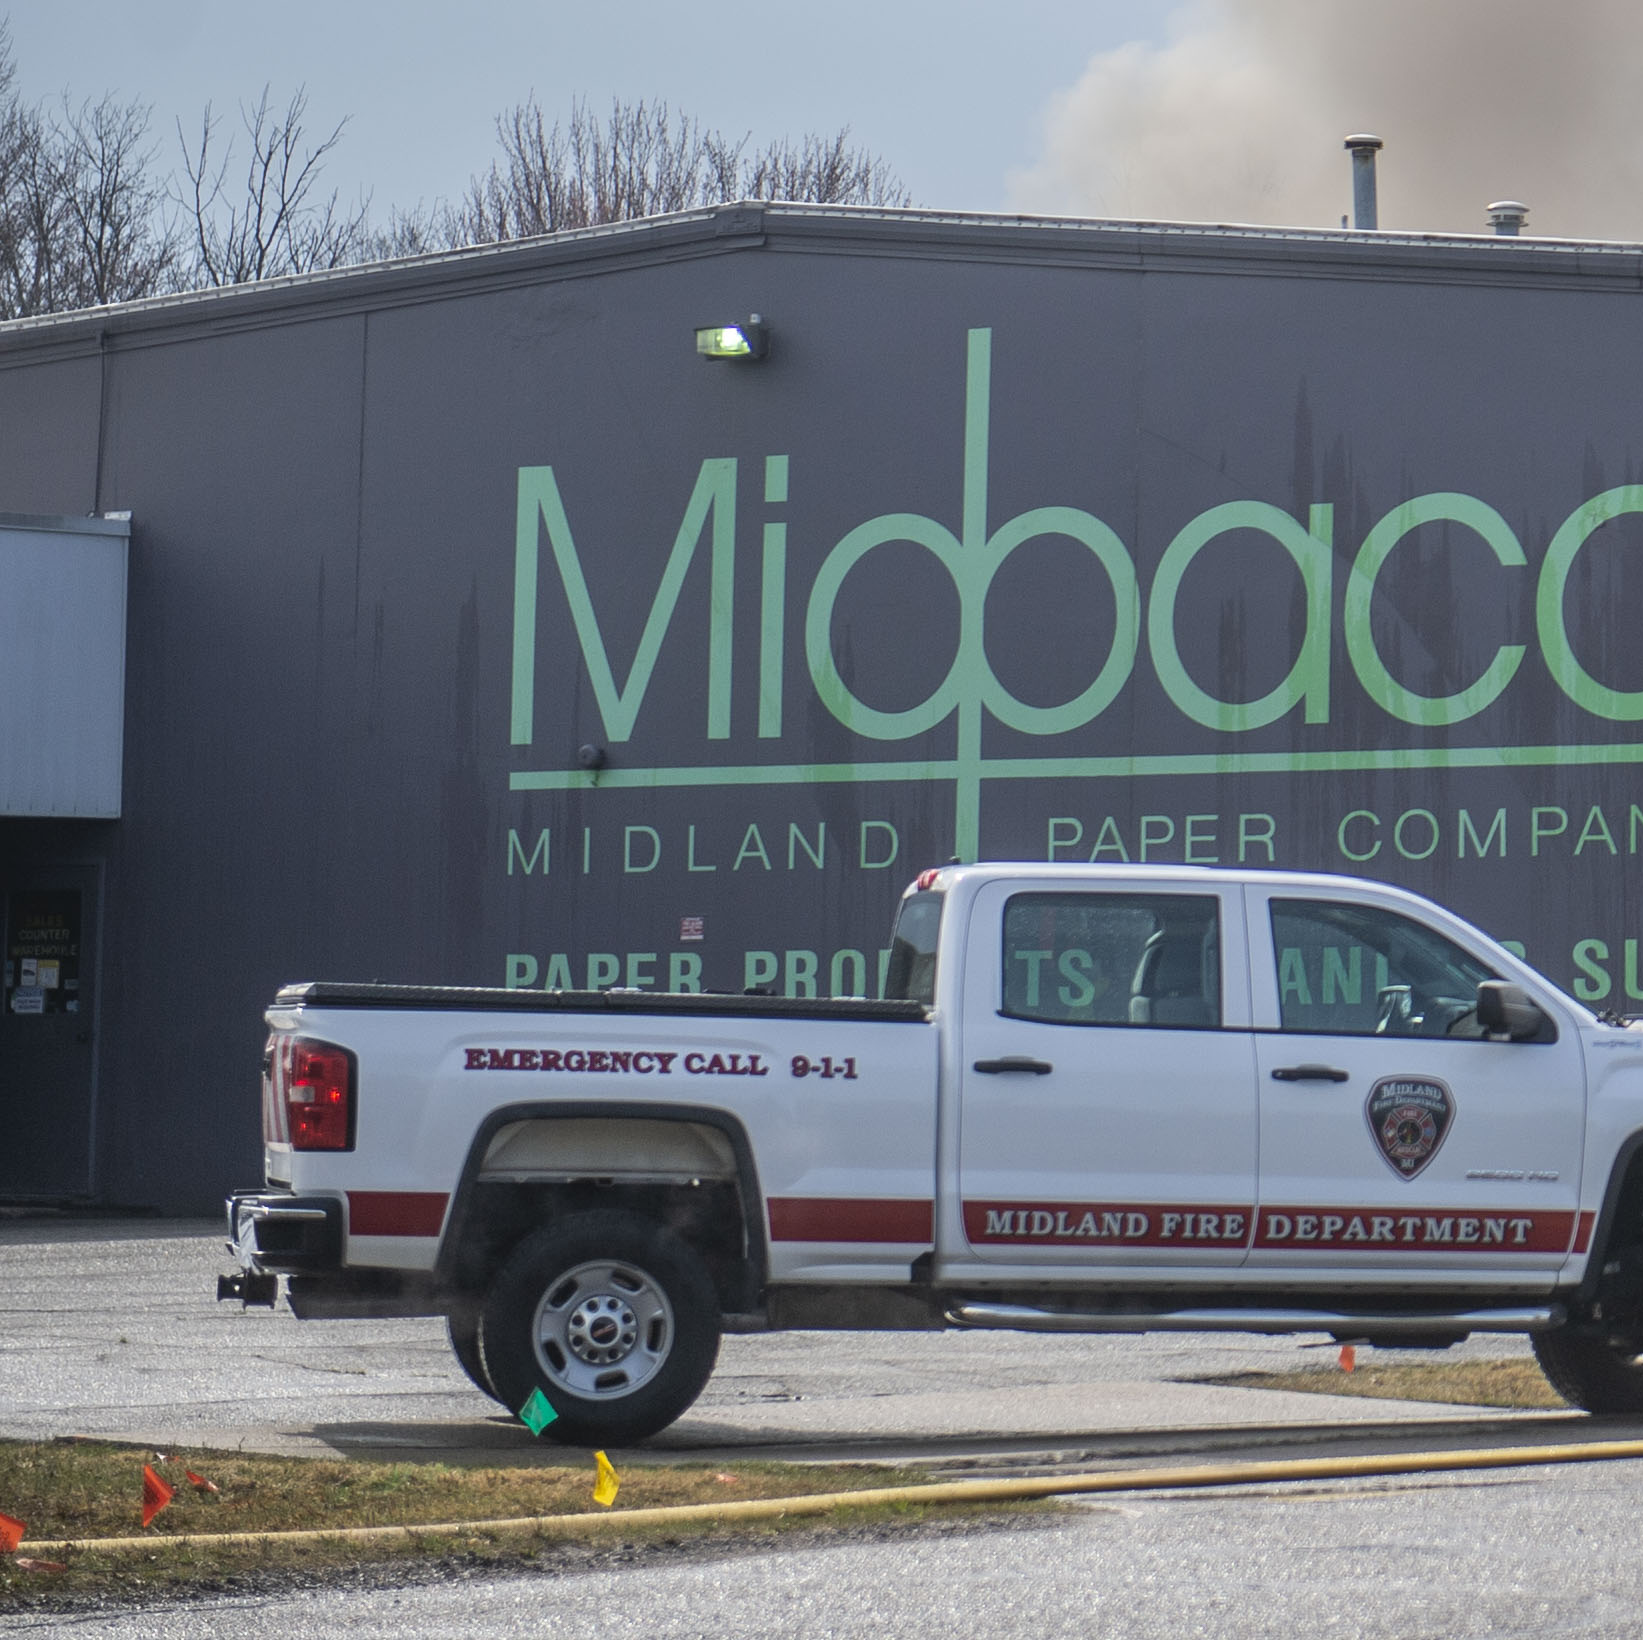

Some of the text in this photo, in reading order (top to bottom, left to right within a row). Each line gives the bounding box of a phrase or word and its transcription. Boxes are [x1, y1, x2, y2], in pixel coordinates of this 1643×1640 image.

[506, 820, 900, 875] MIDLAND
[1047, 812, 1278, 863] PAPER
[505, 952, 703, 993] PAPER
[463, 1048, 859, 1079] EMERGENCY CALL 9-1-1
[1383, 1082, 1443, 1100] MIDLAND
[984, 1210, 1534, 1244] MIDLAND FIRE DEPARTMENT
